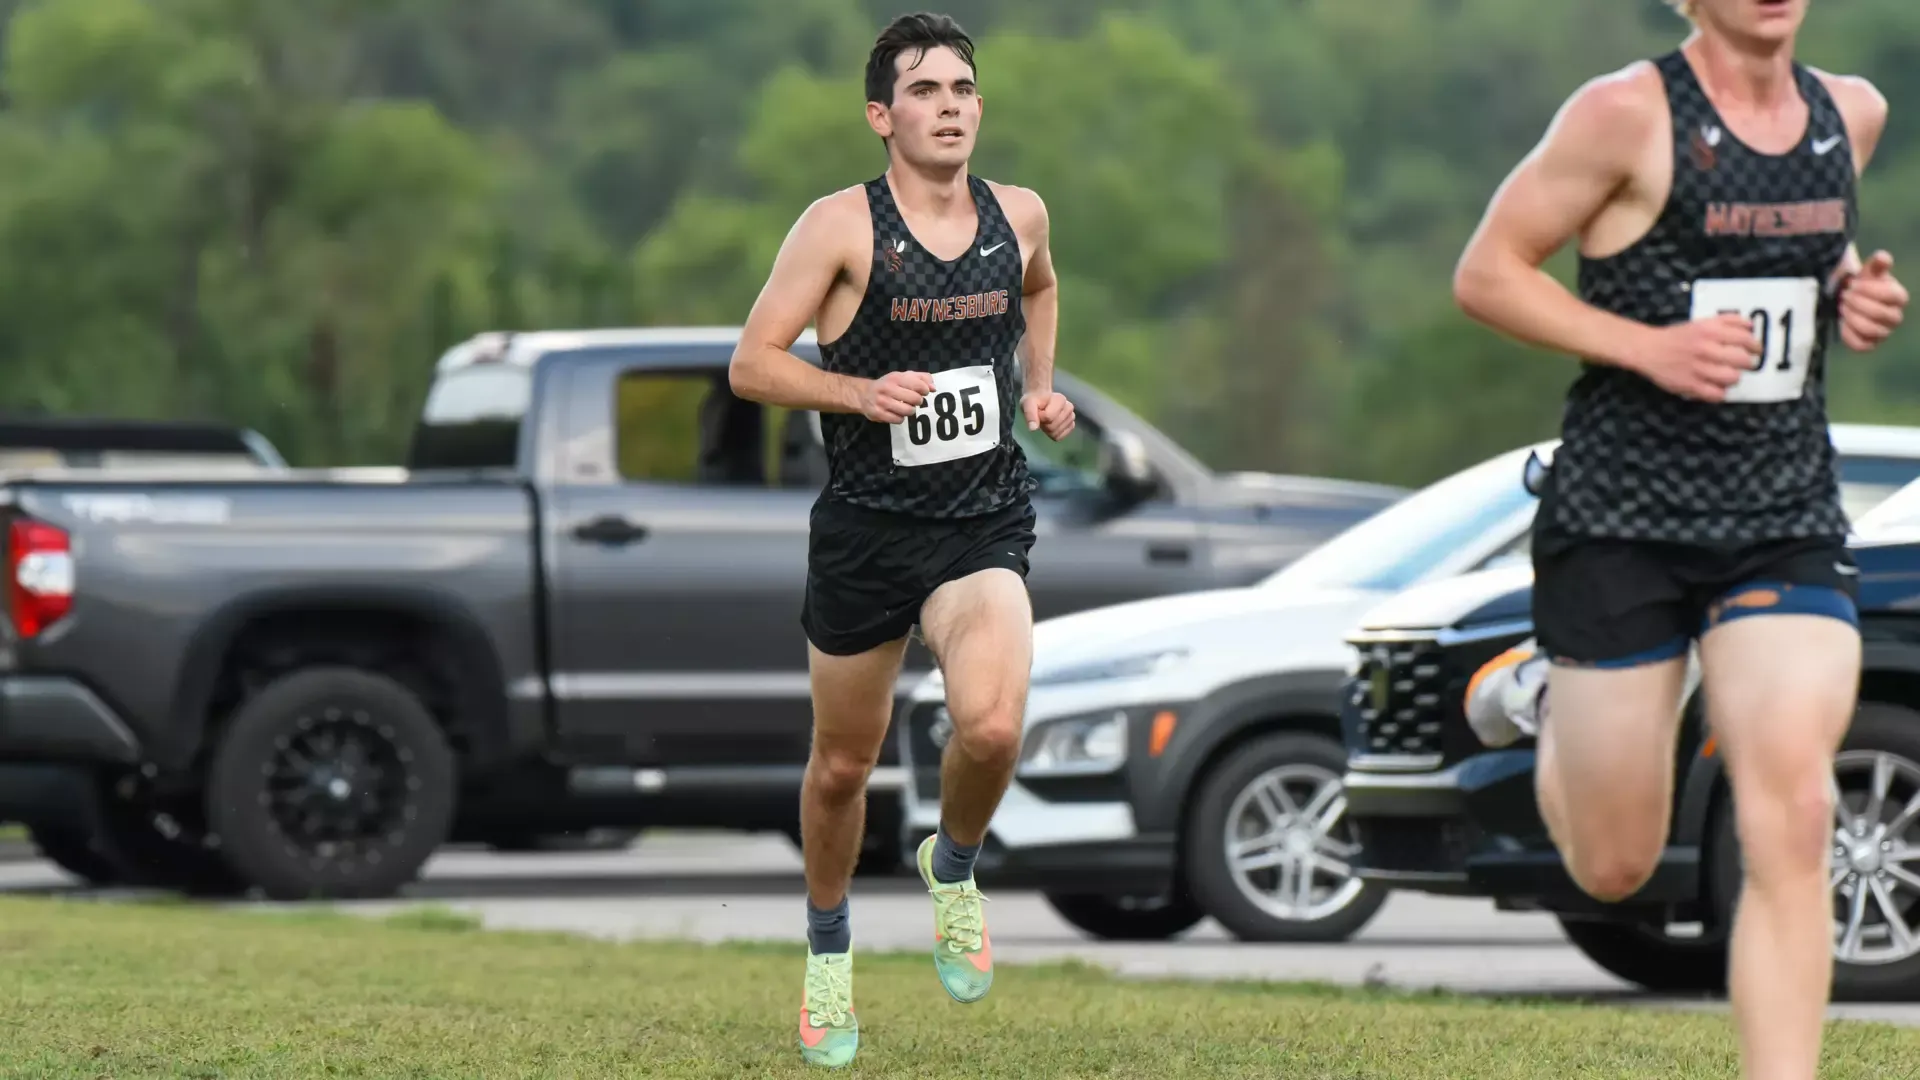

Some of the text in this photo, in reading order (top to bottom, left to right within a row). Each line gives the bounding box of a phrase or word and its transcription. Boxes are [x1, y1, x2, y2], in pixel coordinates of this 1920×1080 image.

[891, 290, 1008, 322] WAYNESBURG
[1716, 307, 1793, 372] 01
[907, 385, 985, 446] 685
